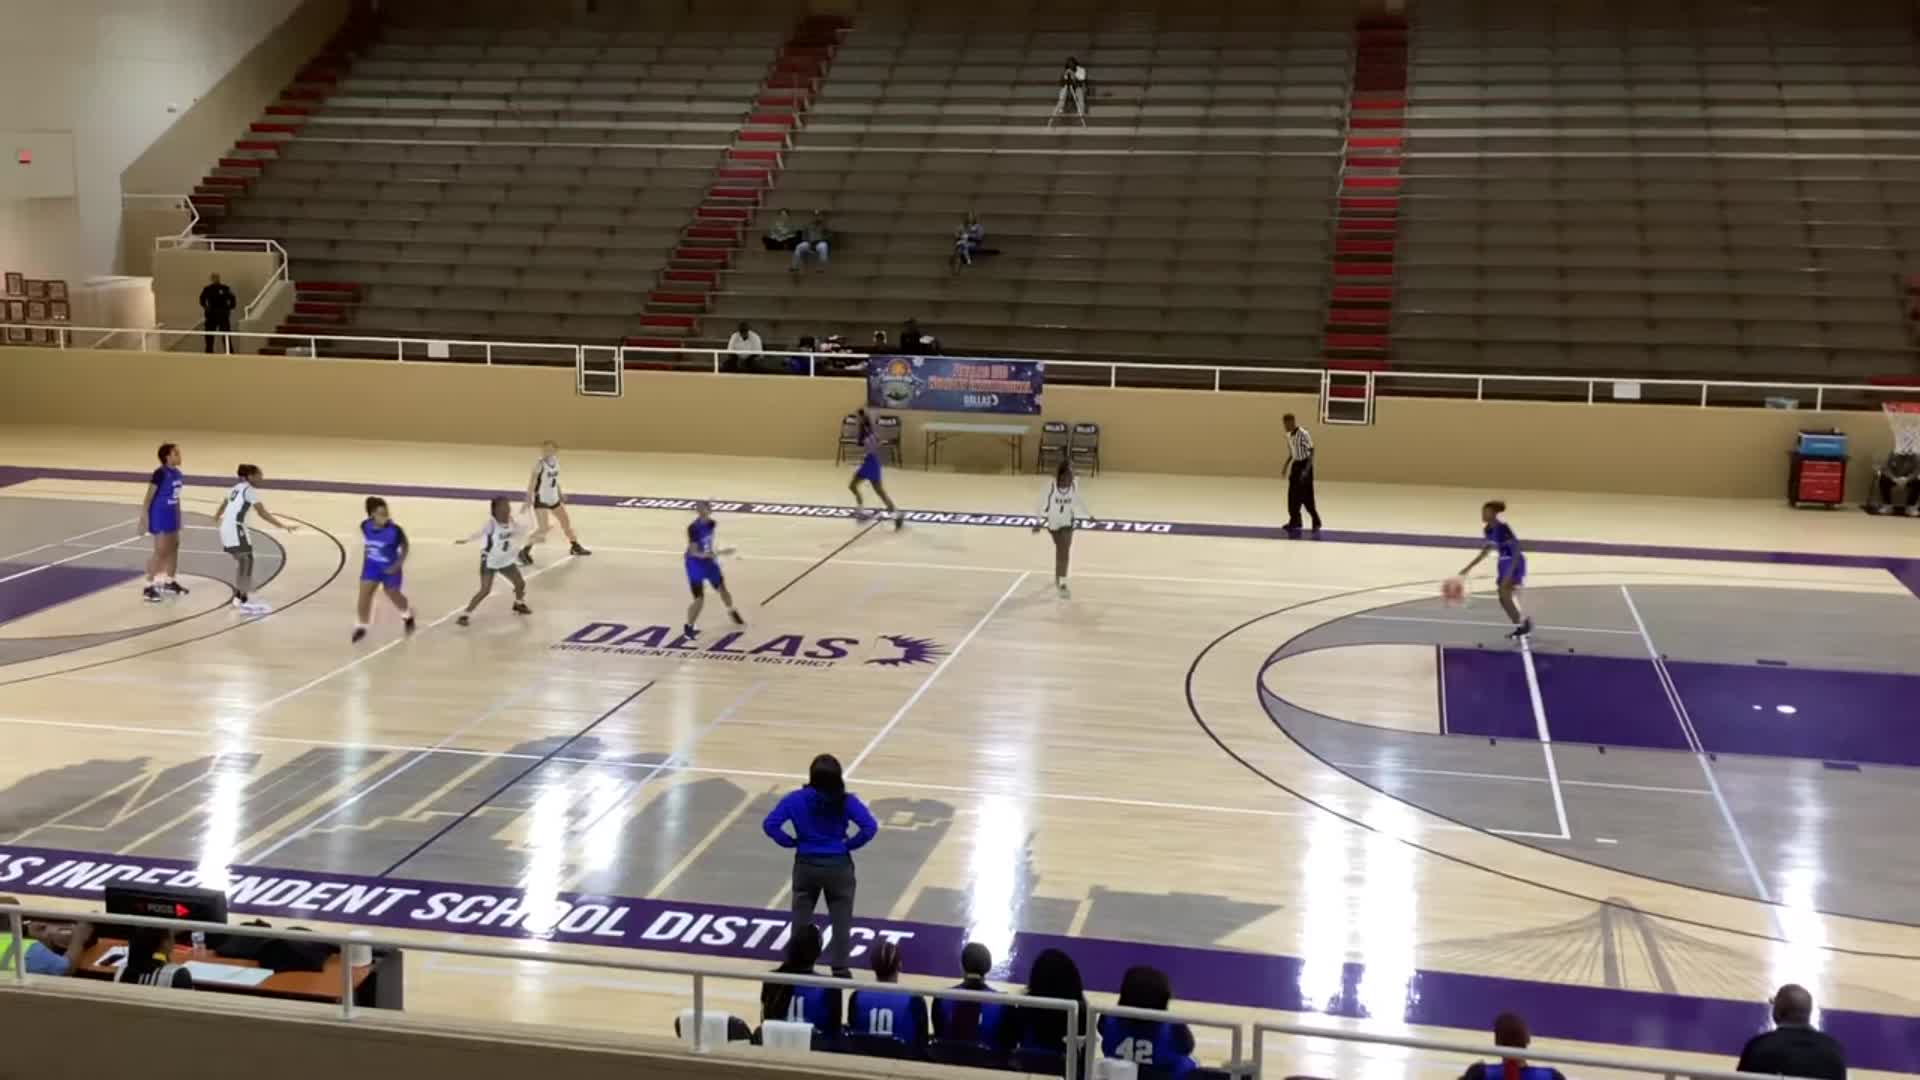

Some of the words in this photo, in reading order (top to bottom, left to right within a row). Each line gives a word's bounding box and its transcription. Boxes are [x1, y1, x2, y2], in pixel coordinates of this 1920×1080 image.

[562, 622, 859, 660] DALLAS
[869, 1007, 893, 1034] 10
[1115, 1036, 1153, 1064] 42
